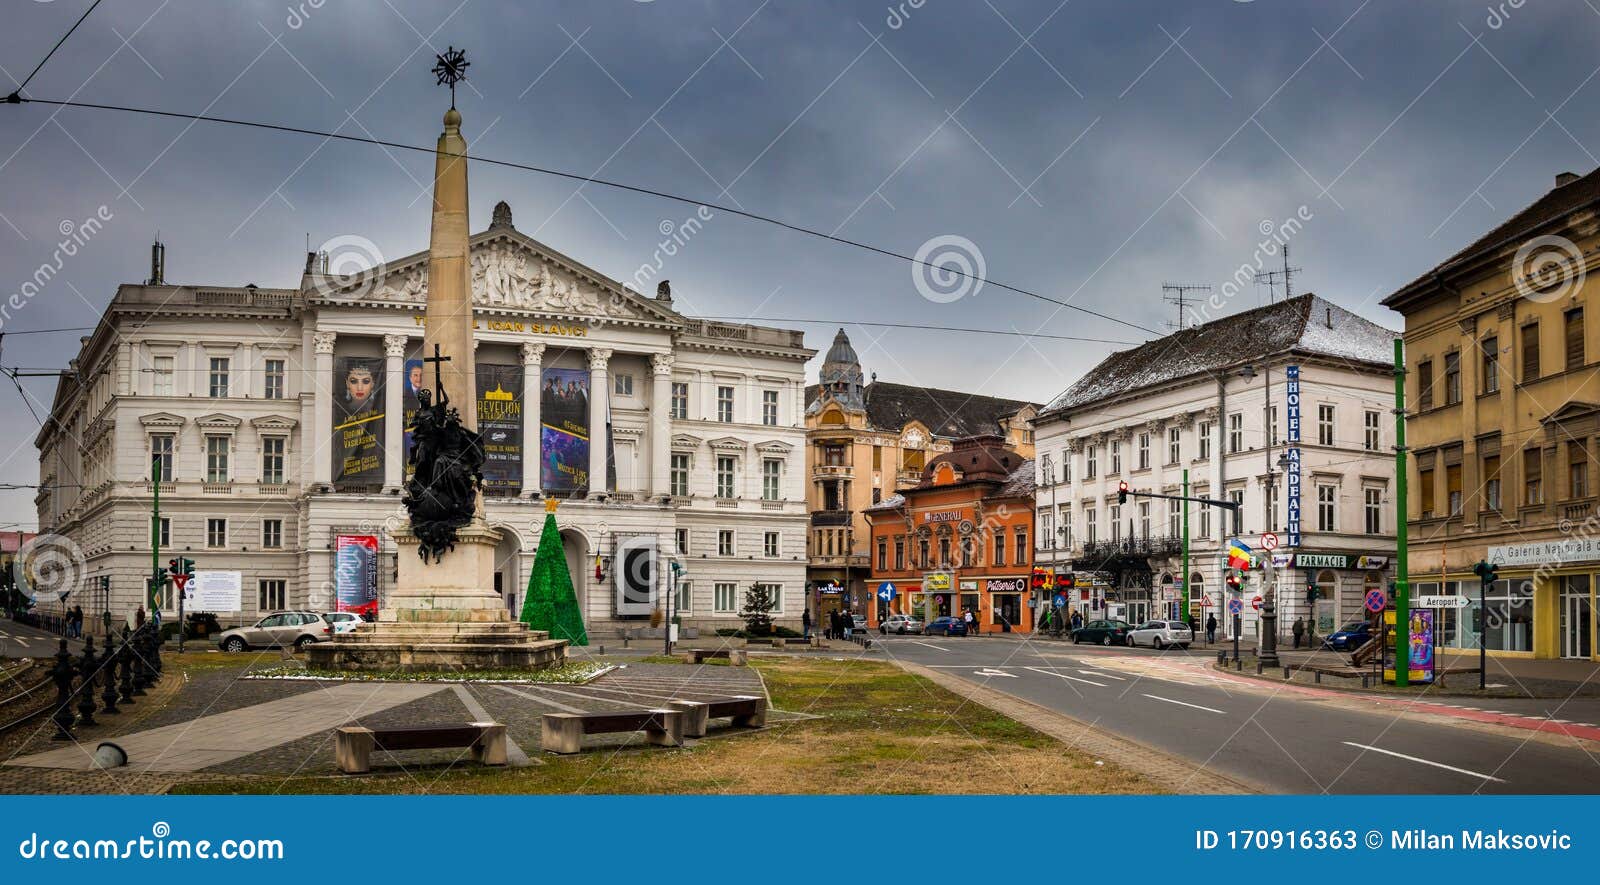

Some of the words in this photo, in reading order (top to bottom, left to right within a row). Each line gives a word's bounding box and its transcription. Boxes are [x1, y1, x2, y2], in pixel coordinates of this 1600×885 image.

[487, 321, 525, 332] IOAN
[532, 323, 588, 337] SLAVICI
[477, 400, 520, 414] REVELION
[1288, 382, 1299, 441] HOTEL
[1288, 450, 1299, 546] ARDEALUL
[930, 510, 963, 521] GENERALI
[1508, 546, 1540, 558] Galeria
[1300, 555, 1344, 567] FARMACIE
[1426, 597, 1457, 608] Aeroport
